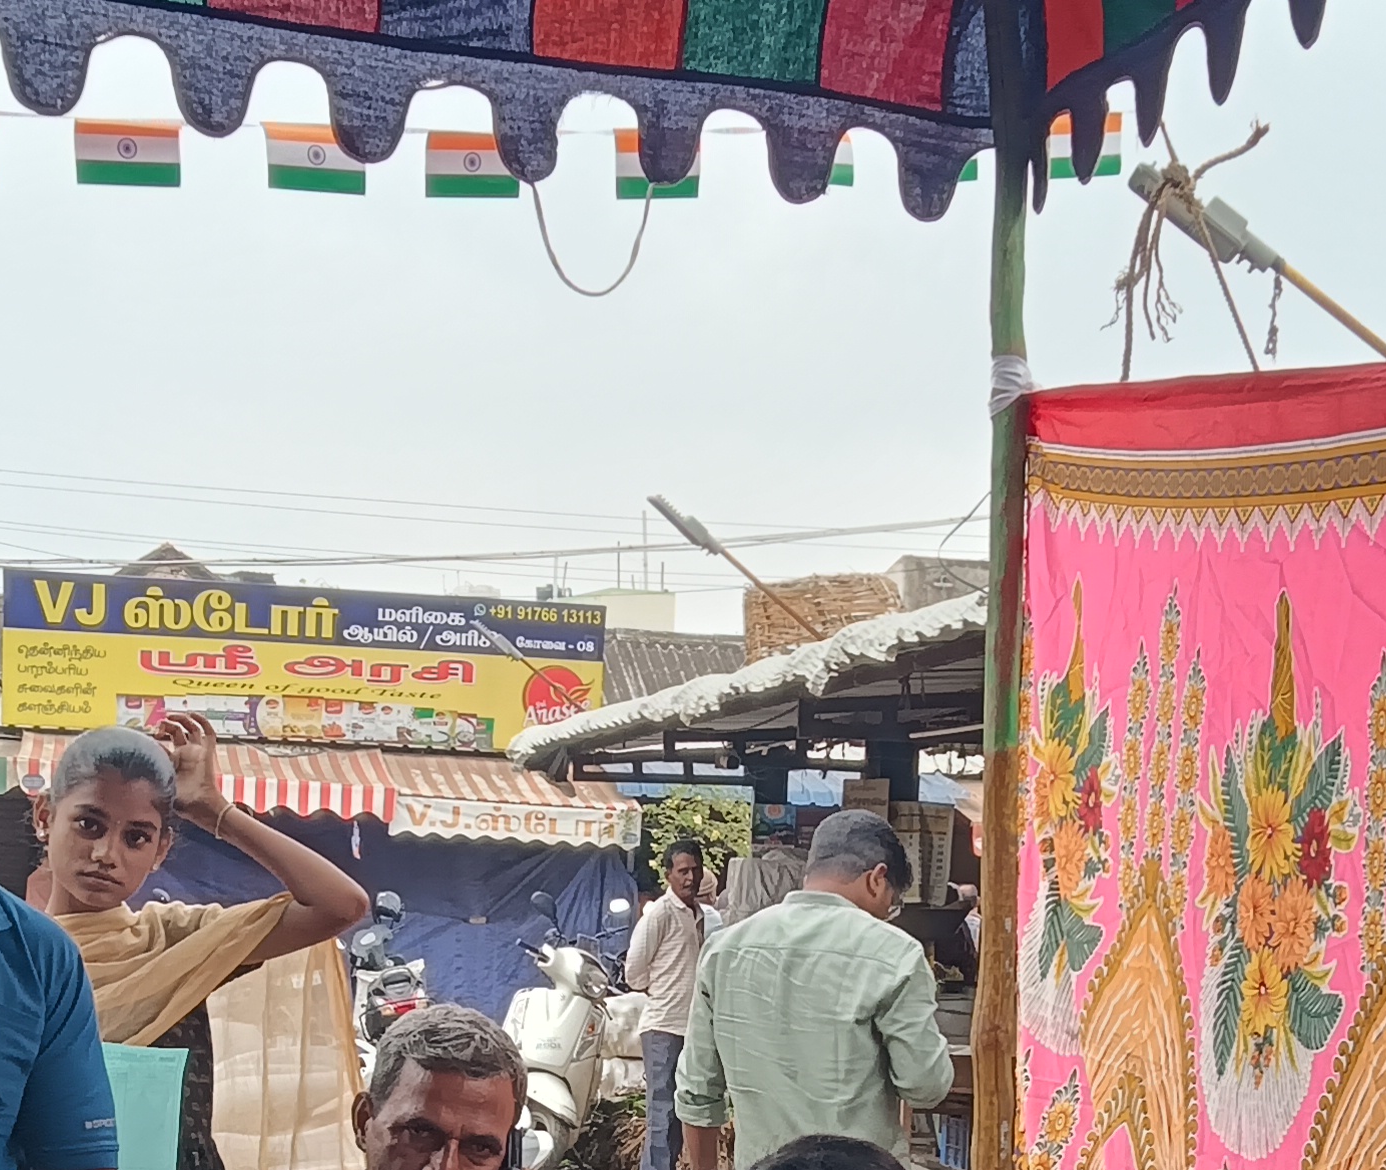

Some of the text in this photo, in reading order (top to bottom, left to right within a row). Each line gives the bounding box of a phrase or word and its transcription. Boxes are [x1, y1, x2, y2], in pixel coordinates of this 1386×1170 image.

[34, 580, 339, 638] VJ ஸ்டோர்
[378, 607, 466, 626] மளிகை
[489, 604, 601, 625] +91 91766 13113
[343, 624, 418, 644] ஆயில்
[516, 636, 566, 651] கோவை
[577, 641, 595, 652] 08
[284, 654, 475, 687] அரசி
[172, 678, 442, 700] Queen of good Taste
